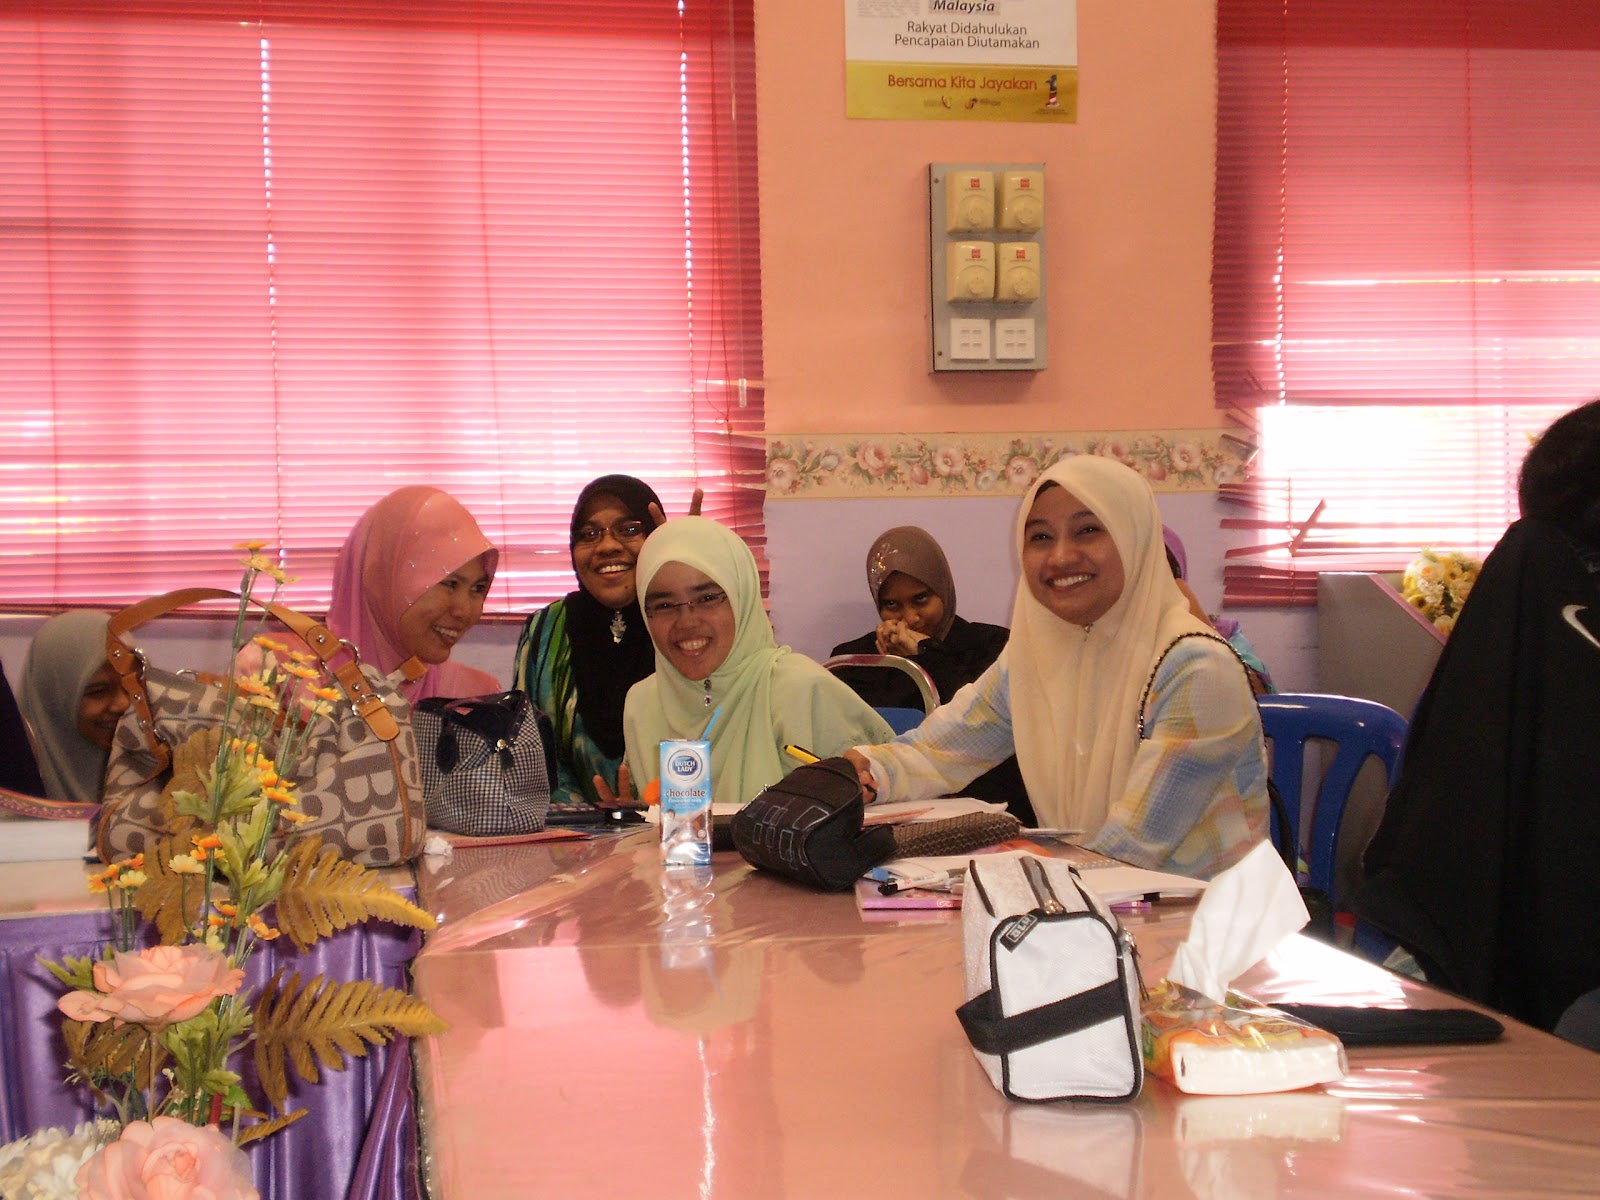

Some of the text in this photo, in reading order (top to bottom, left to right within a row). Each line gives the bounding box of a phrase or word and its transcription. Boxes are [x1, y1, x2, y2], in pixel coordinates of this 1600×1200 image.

[933, 0, 995, 14] Malaysia
[907, 21, 1027, 35] Rakyat Didahulukan
[894, 34, 1040, 49] Pencapaian Diutamakan
[888, 74, 1037, 92] Bersama Kita Jayakan
[665, 788, 705, 797] chocolate
